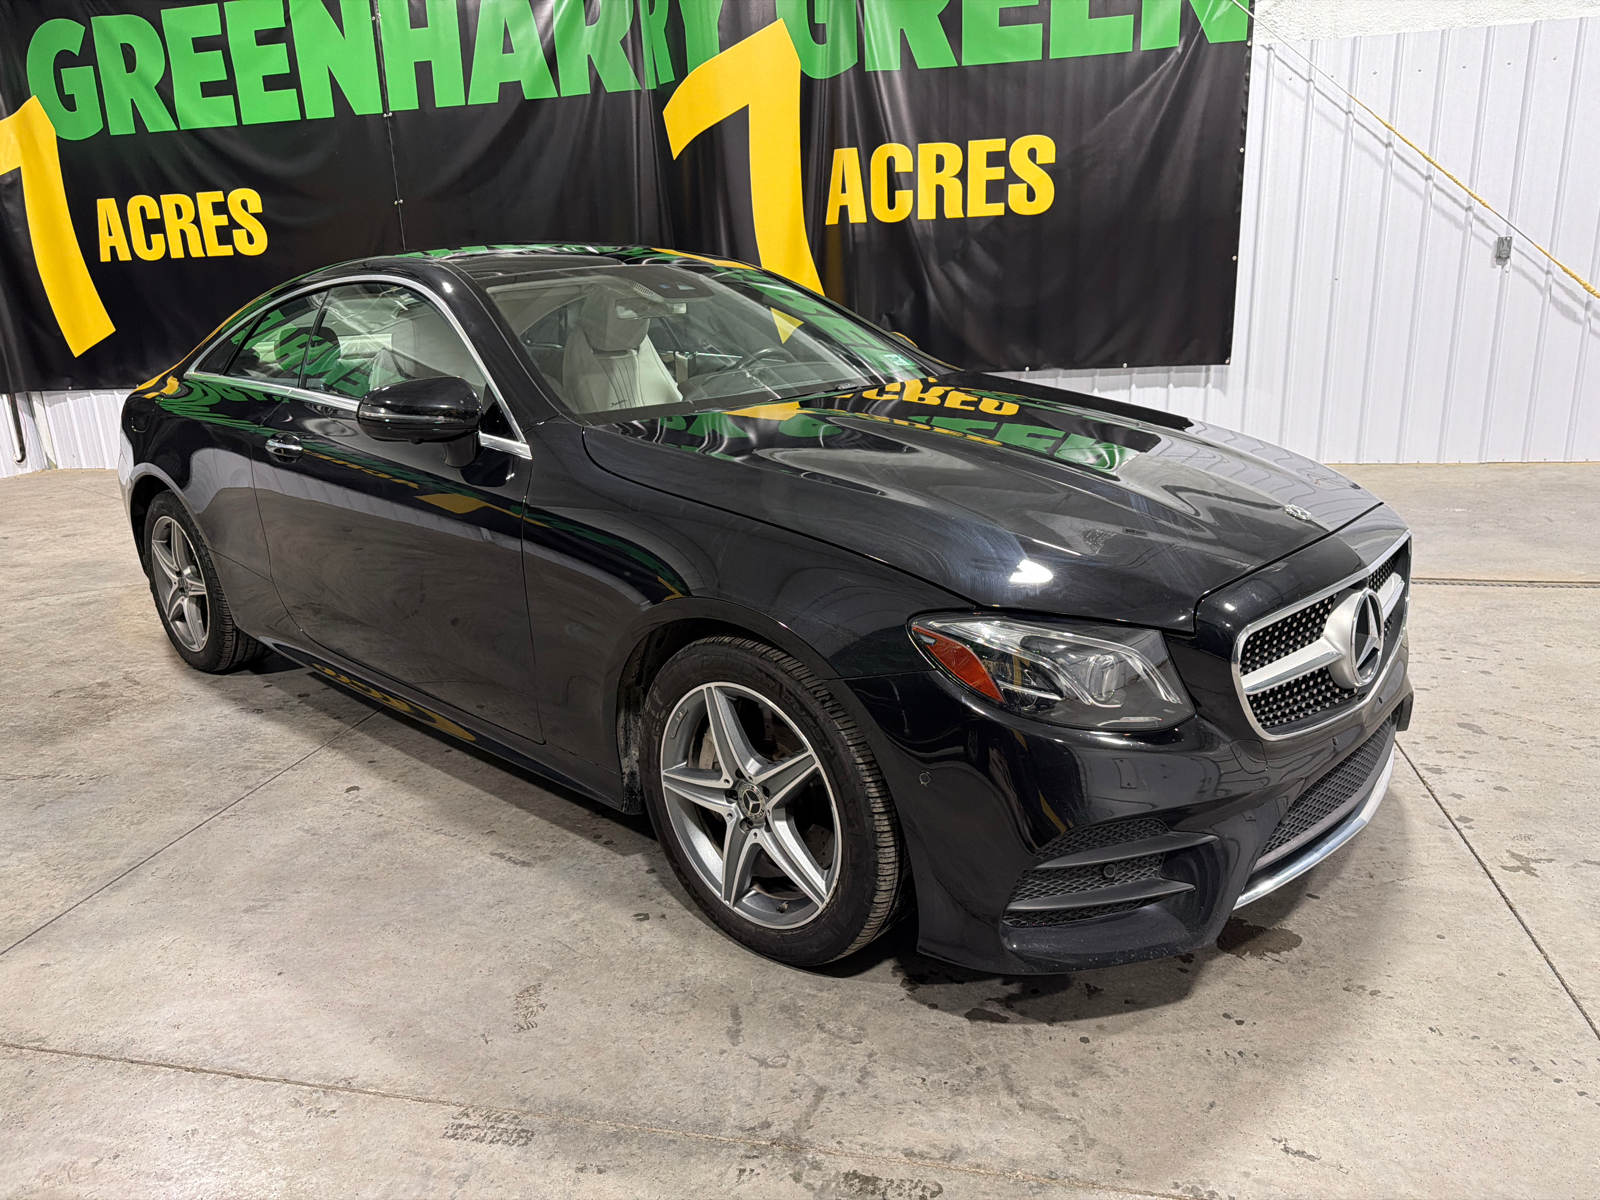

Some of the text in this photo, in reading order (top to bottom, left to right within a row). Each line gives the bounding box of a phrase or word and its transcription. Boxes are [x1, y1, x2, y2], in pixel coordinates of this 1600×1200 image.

[26, 0, 383, 141] GREEN
[97, 188, 269, 263] ACRES
[662, 18, 1057, 298] 7 ACRES
